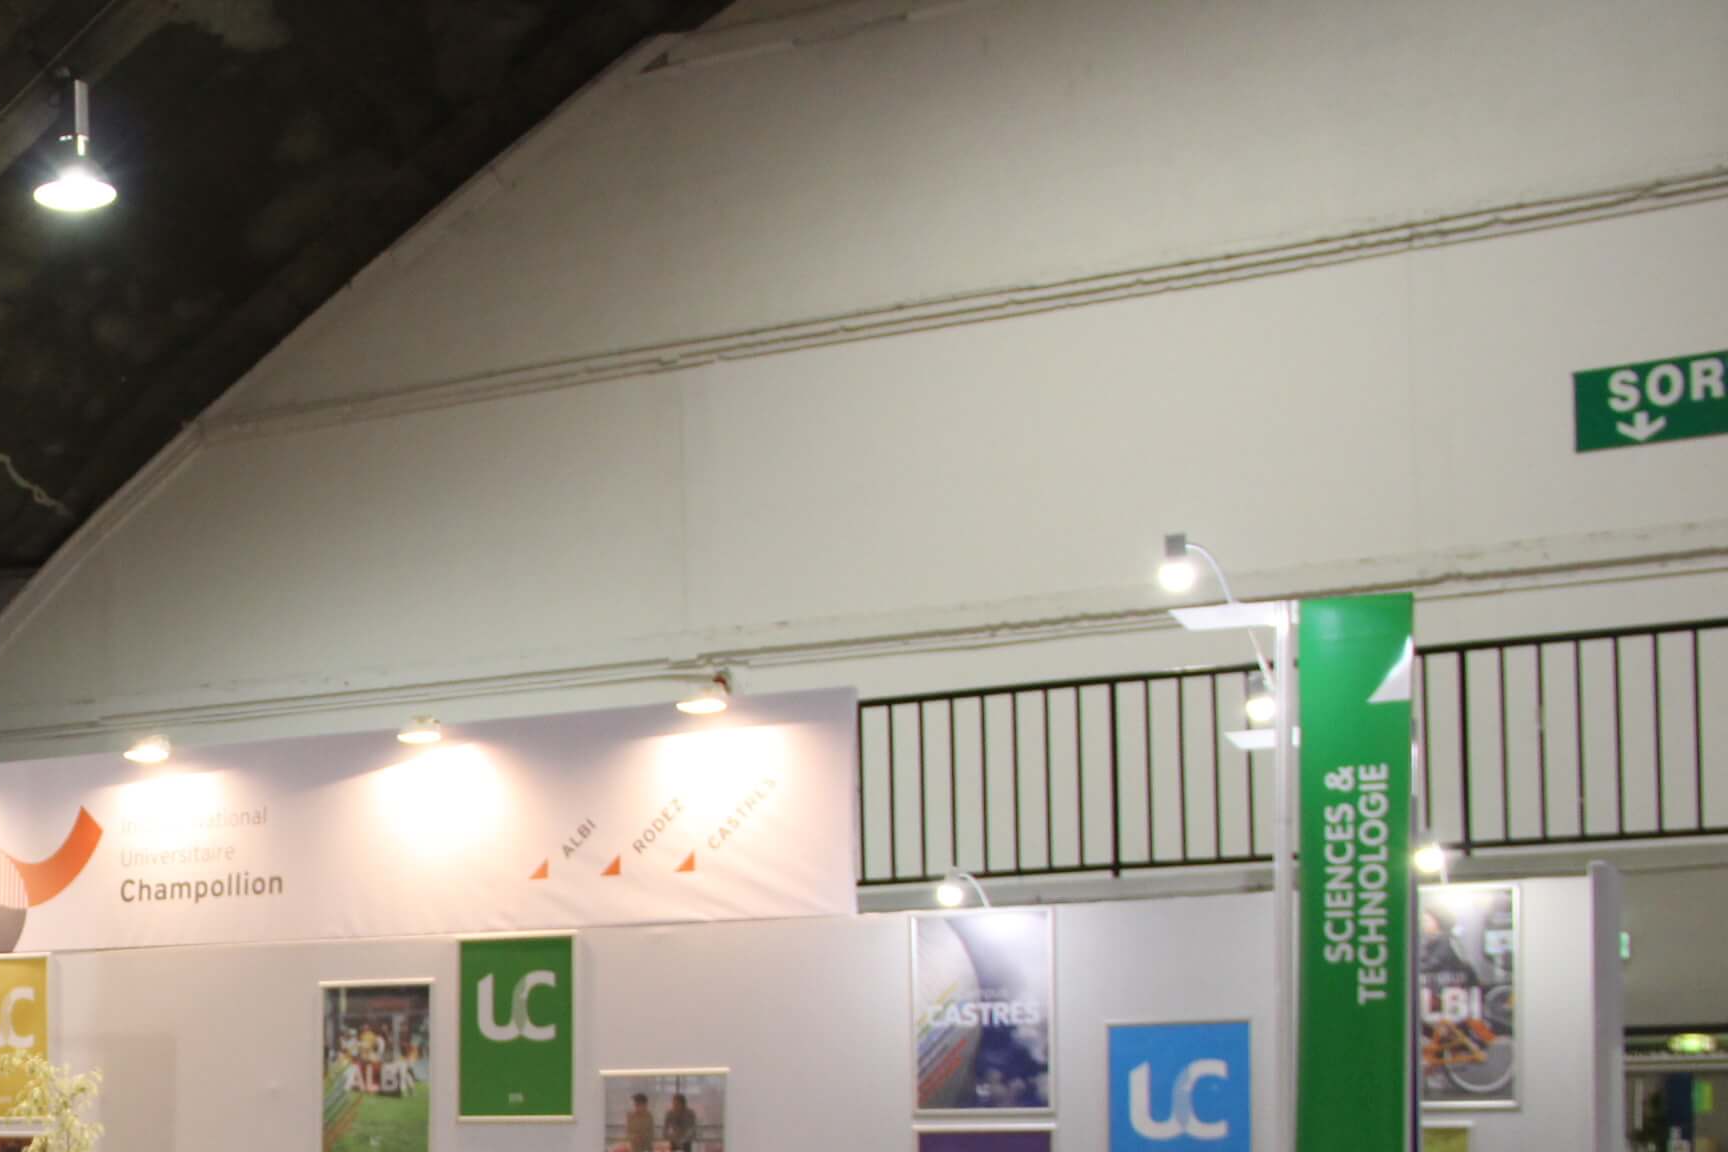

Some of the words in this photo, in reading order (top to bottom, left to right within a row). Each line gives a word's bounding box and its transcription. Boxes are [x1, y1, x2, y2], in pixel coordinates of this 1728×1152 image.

[1608, 357, 1725, 412] SOR
[1324, 765, 1355, 792] &
[561, 817, 597, 860] ALBI
[632, 797, 684, 855] RODEZ
[120, 870, 283, 904] Champollion
[1324, 802, 1355, 964] SCIENCES
[1357, 763, 1389, 1006] TECHNOLOGIE
[477, 970, 557, 1041] UC
[927, 1001, 1042, 1027] CASTRES
[1421, 985, 1484, 1023] LBI
[1129, 1059, 1229, 1140] UC
